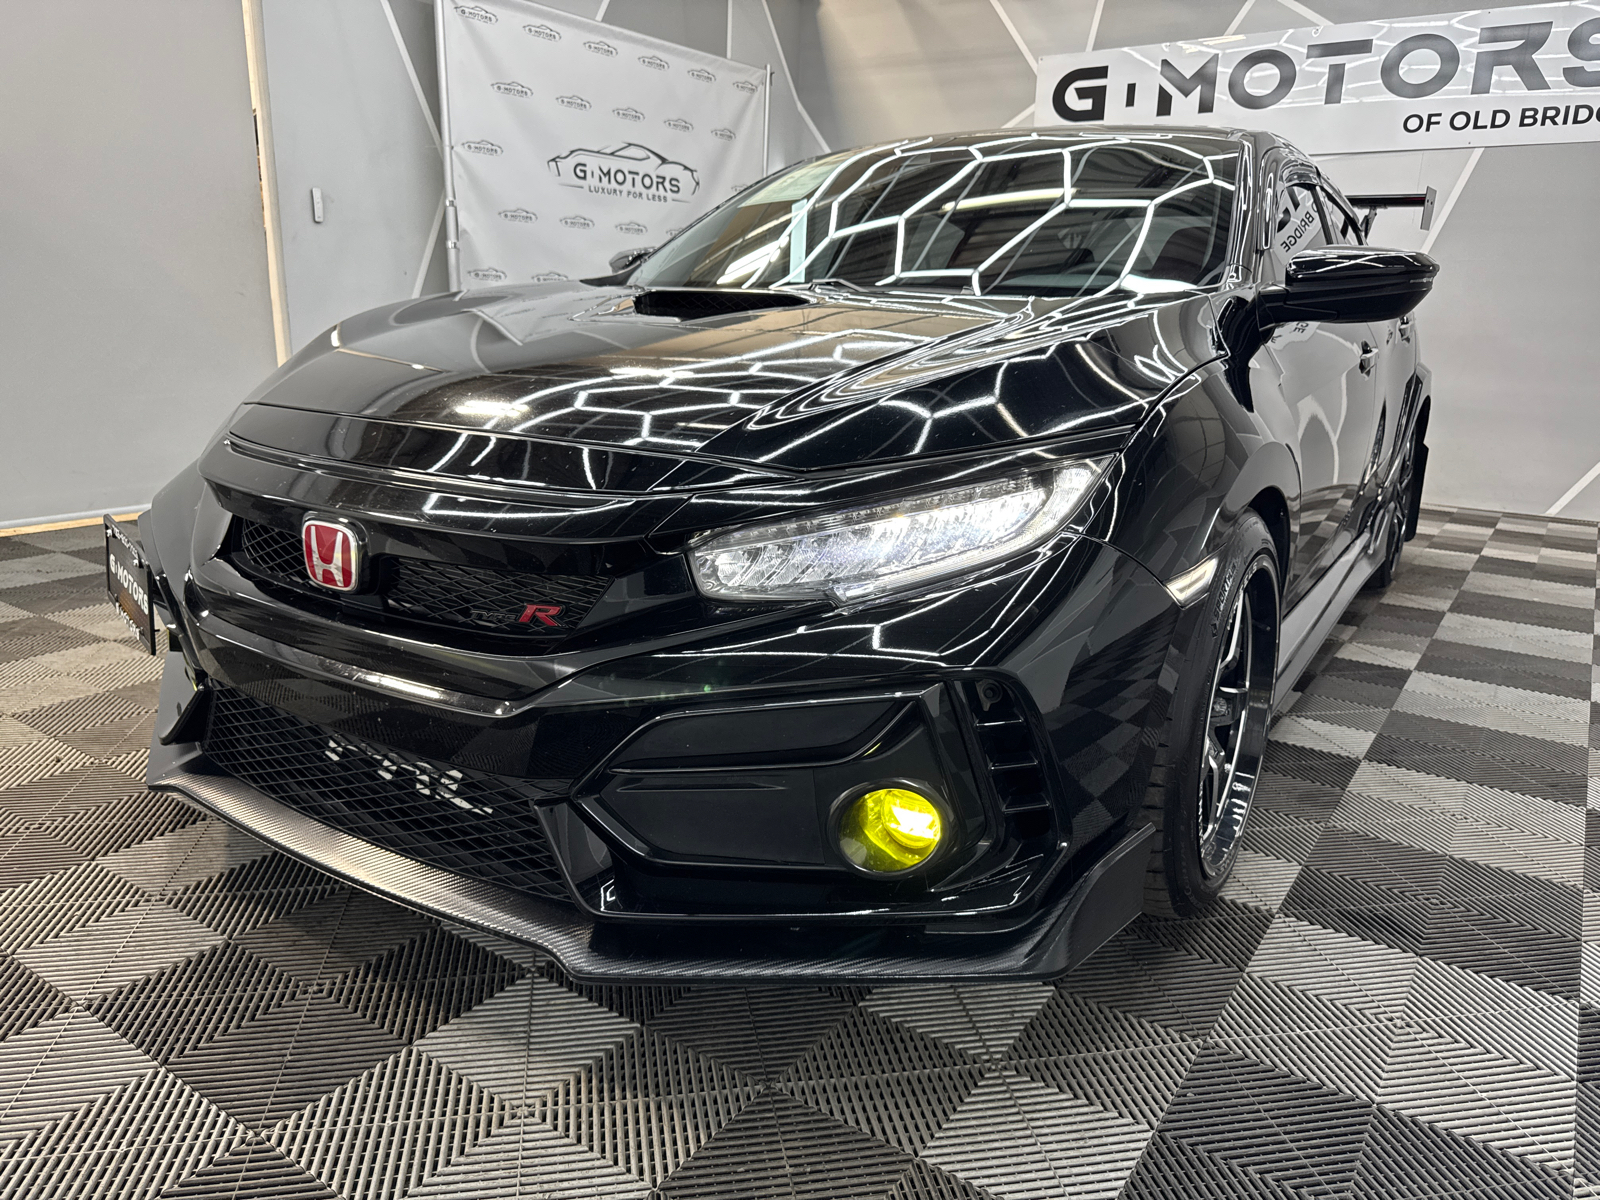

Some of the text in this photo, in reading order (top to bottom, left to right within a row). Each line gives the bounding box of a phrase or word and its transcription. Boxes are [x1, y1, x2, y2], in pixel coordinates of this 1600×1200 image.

[1402, 104, 1600, 134] OF OLD BRID
[588, 184, 669, 203] LUXURY FOR LESS
[519, 604, 563, 627] R
